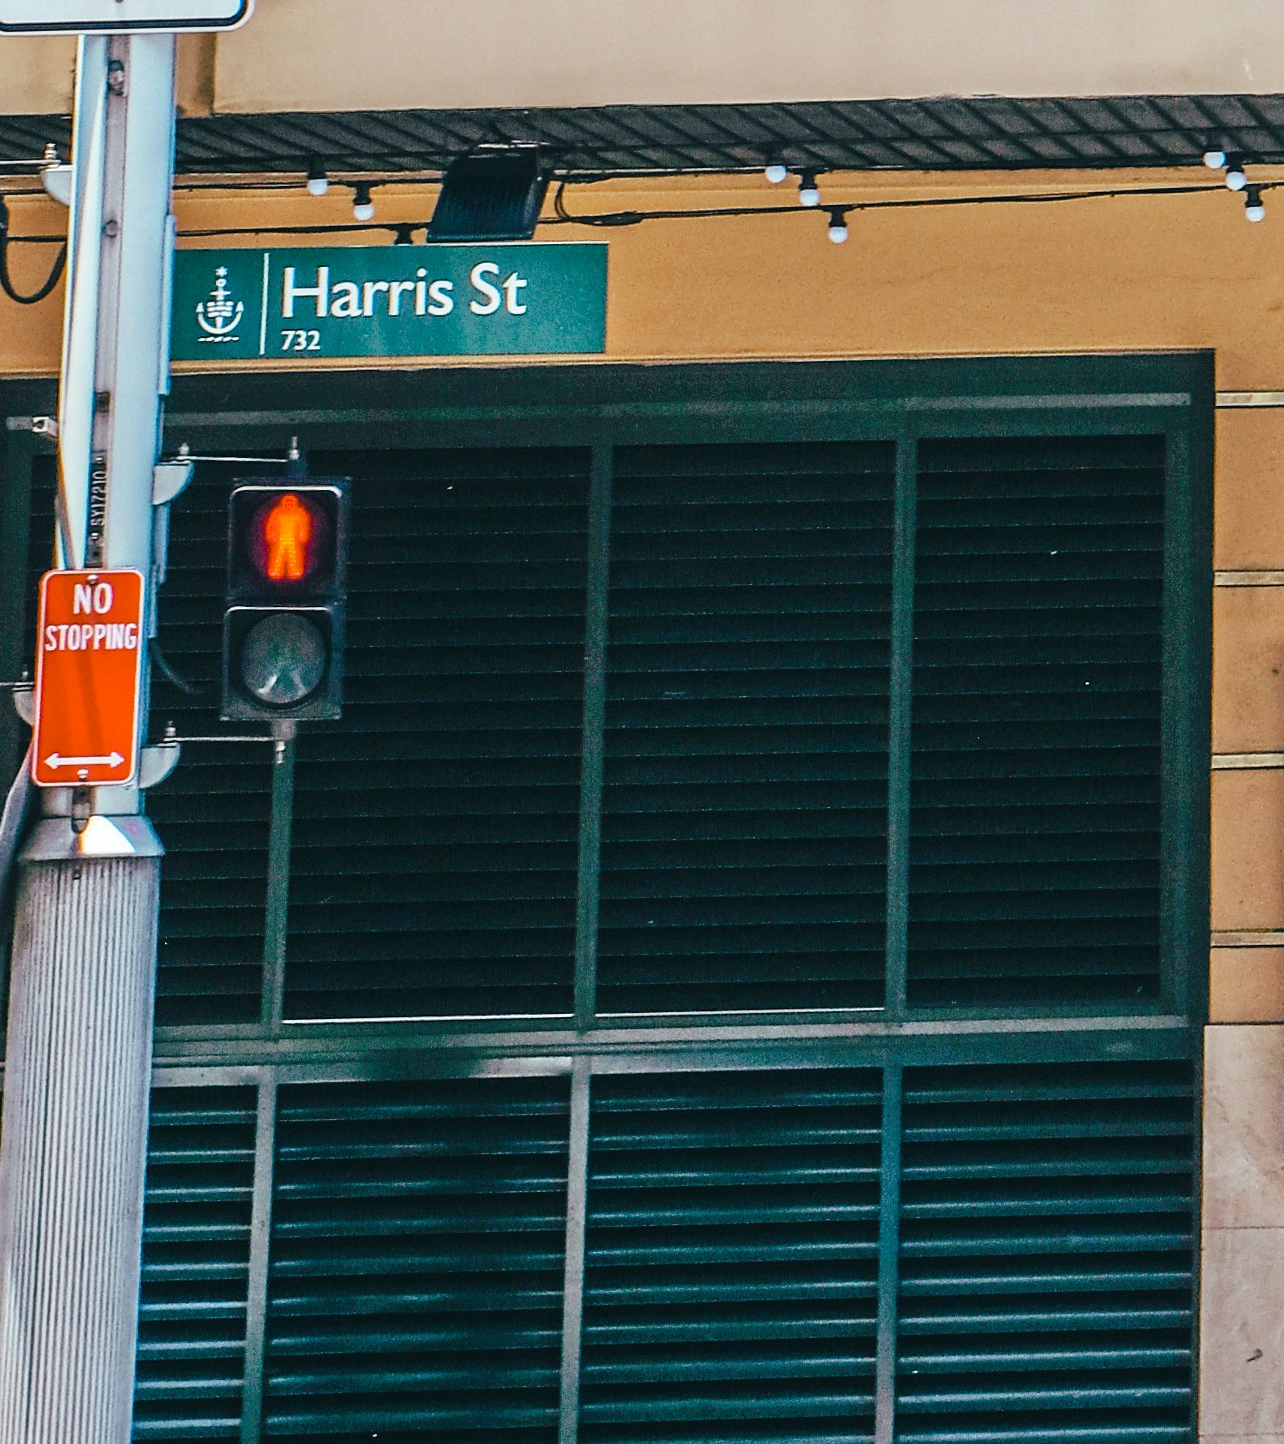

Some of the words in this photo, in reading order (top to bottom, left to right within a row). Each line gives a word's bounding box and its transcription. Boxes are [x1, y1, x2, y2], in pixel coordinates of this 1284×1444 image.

[282, 265, 454, 318] Harris
[469, 263, 528, 316] St
[281, 330, 321, 351] 732
[73, 583, 113, 615] NO
[45, 623, 138, 651] STOPPING
